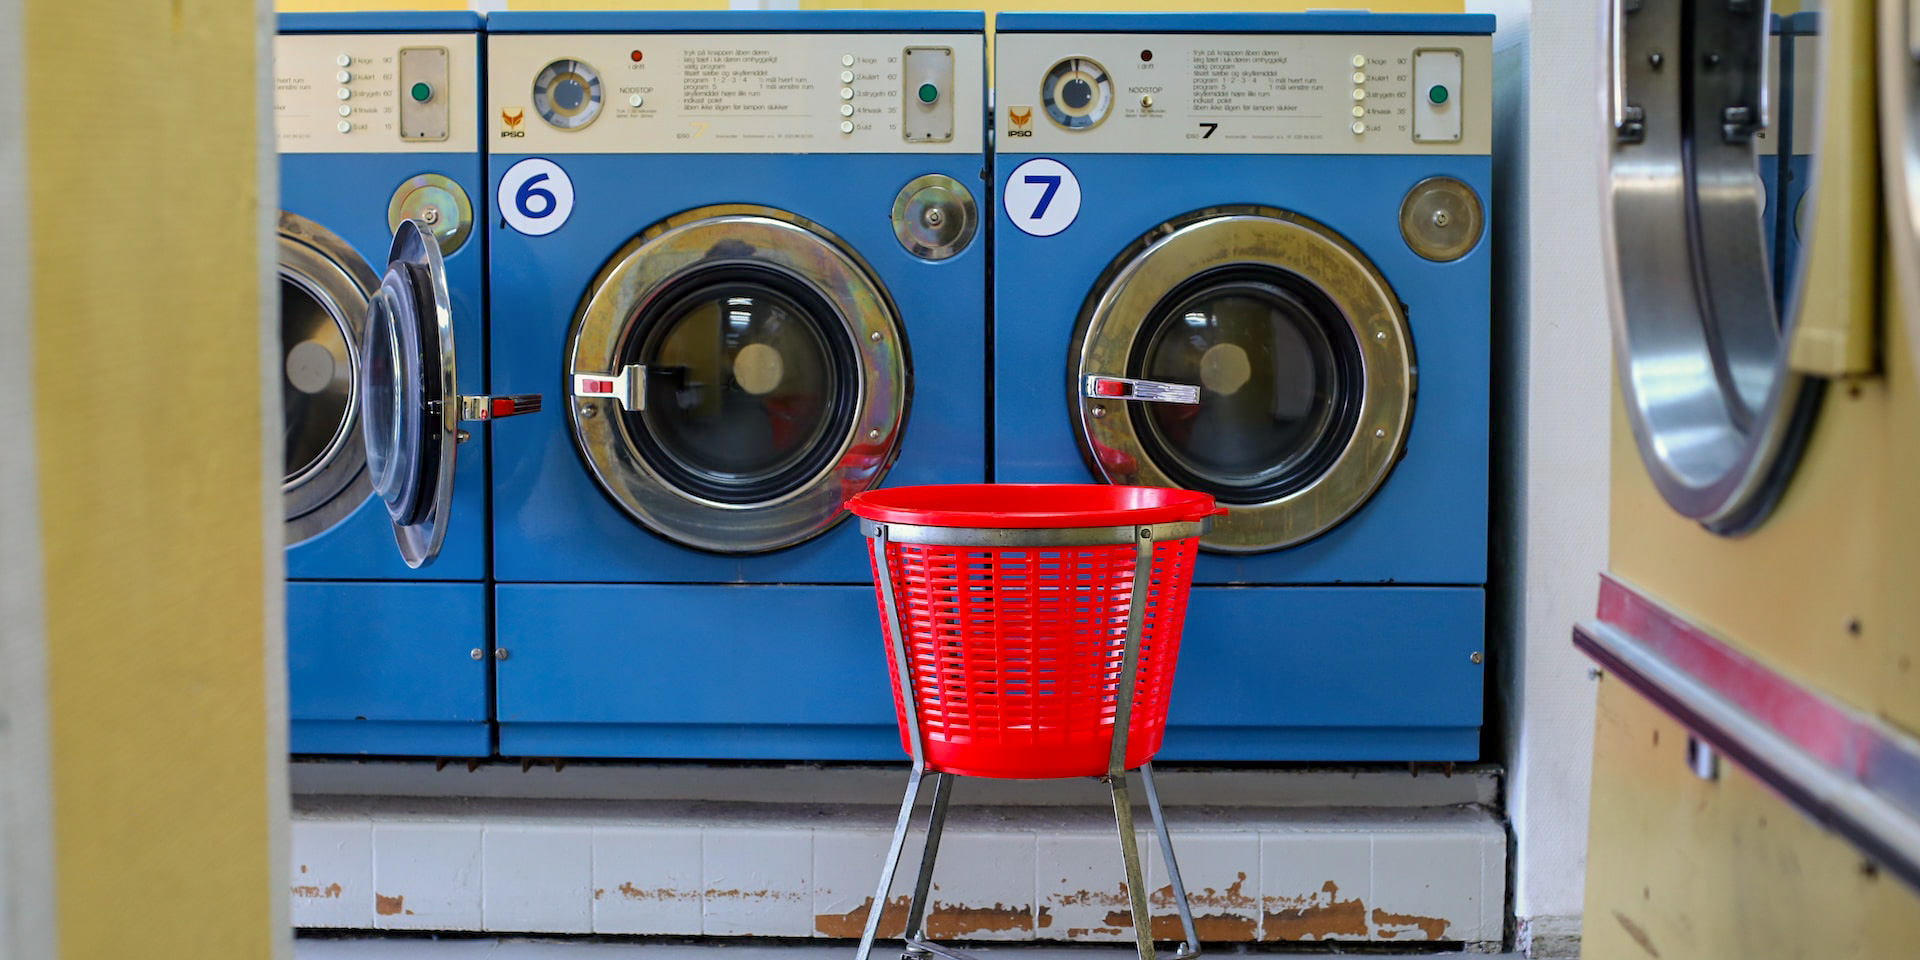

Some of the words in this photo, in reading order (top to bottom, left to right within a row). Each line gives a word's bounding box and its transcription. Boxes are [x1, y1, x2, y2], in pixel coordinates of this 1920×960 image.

[1199, 123, 1218, 139] 7
[515, 172, 558, 219] 6
[1024, 175, 1062, 219] 7
